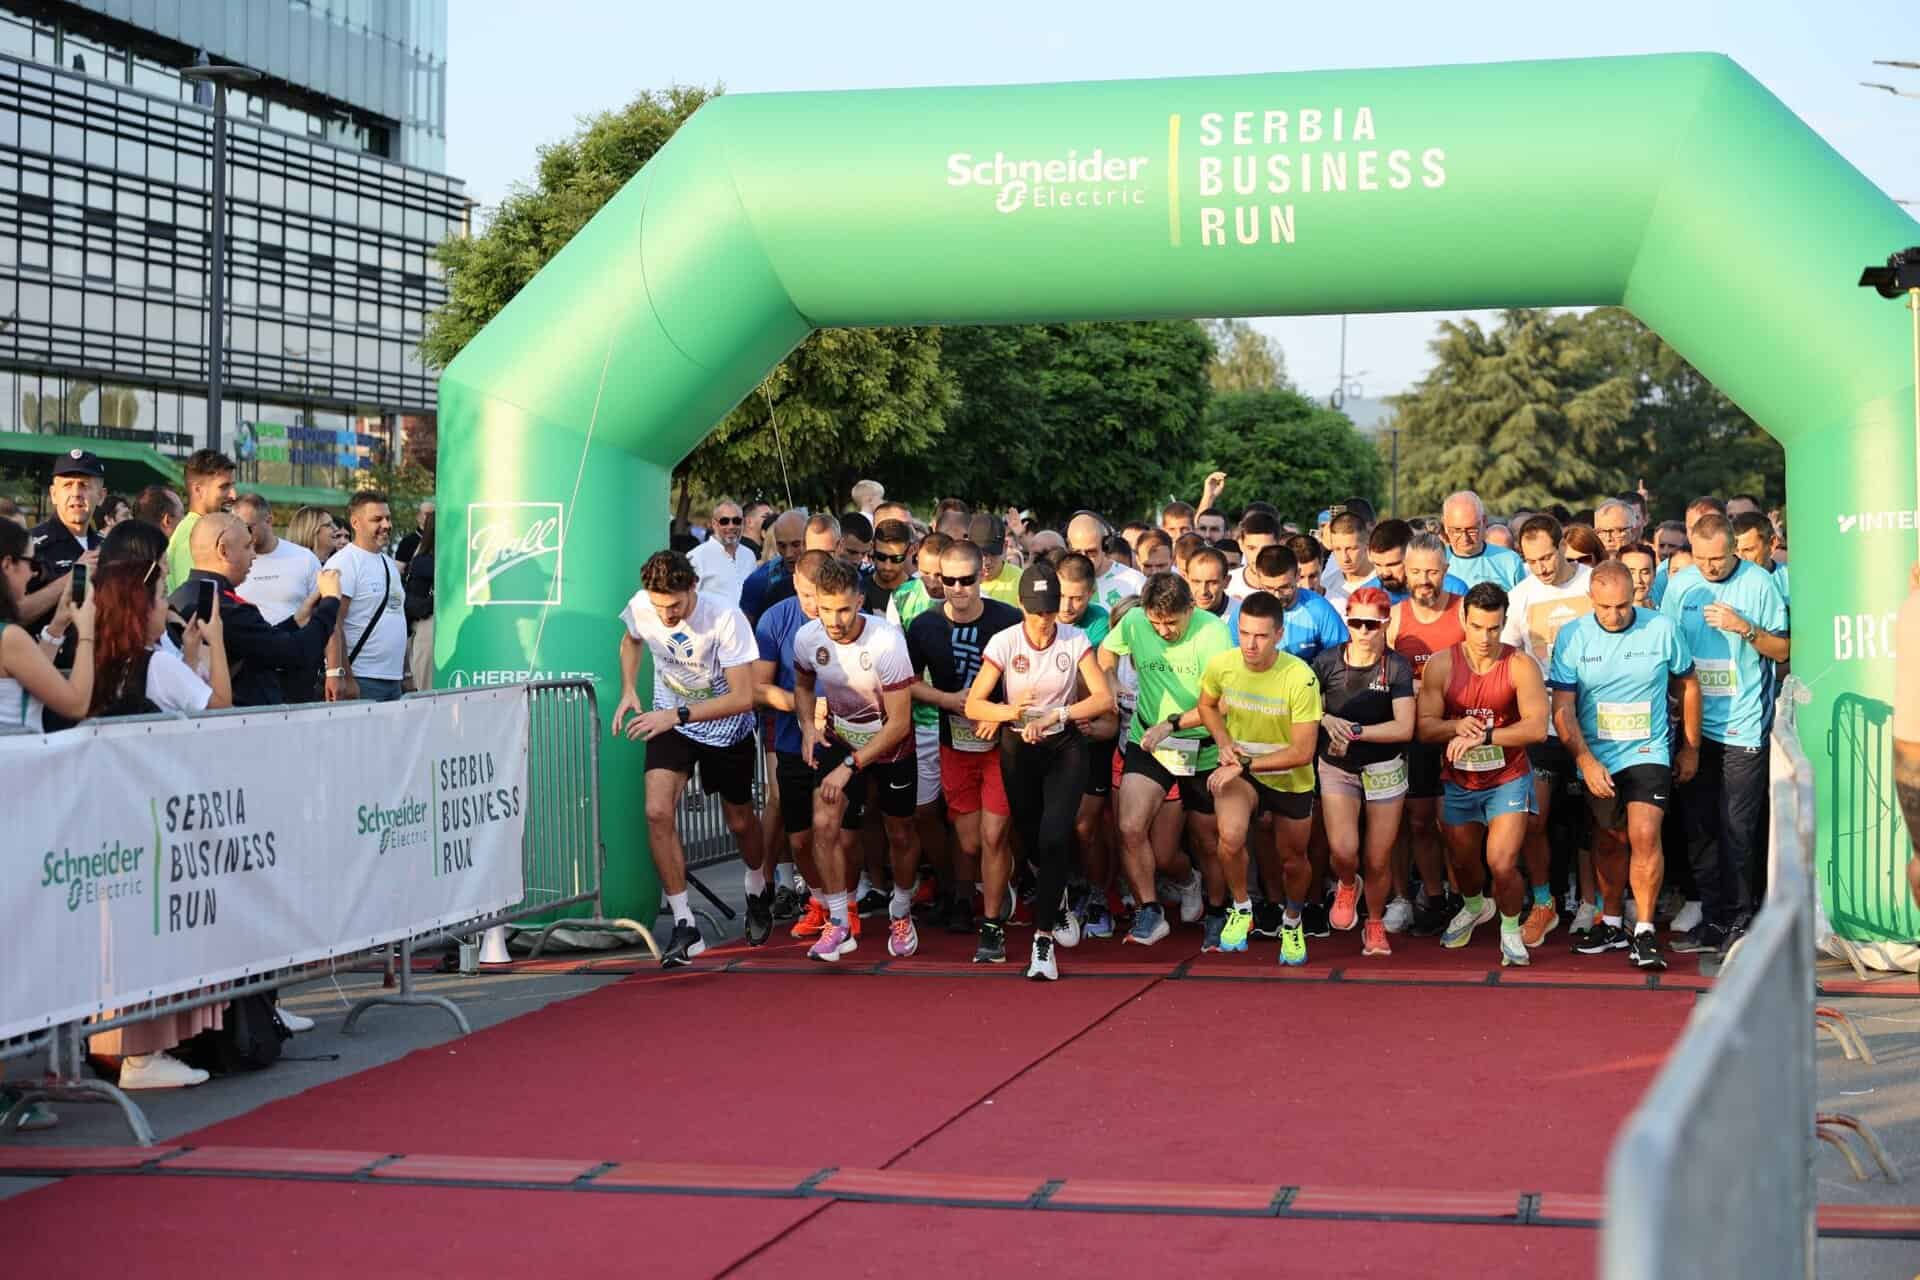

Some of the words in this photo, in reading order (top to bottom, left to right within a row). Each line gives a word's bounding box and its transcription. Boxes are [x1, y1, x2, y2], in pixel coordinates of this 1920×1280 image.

[1200, 106, 1377, 147] SERBIA
[947, 149, 1149, 187] Schneider
[1200, 147, 1448, 198] BUSINESS
[1034, 184, 1146, 209] Electric
[1200, 204, 1297, 247] RUN
[440, 751, 495, 792] SERBIA
[166, 787, 246, 833] SERBIA
[357, 796, 428, 836] Schneider
[442, 785, 520, 833] BUSINESS
[170, 831, 276, 883] BUSINESS
[391, 830, 428, 849] Electric
[443, 837, 474, 875] RUN
[41, 839, 145, 888] Schneider
[86, 879, 143, 905] Electric
[169, 887, 217, 933] RUN
